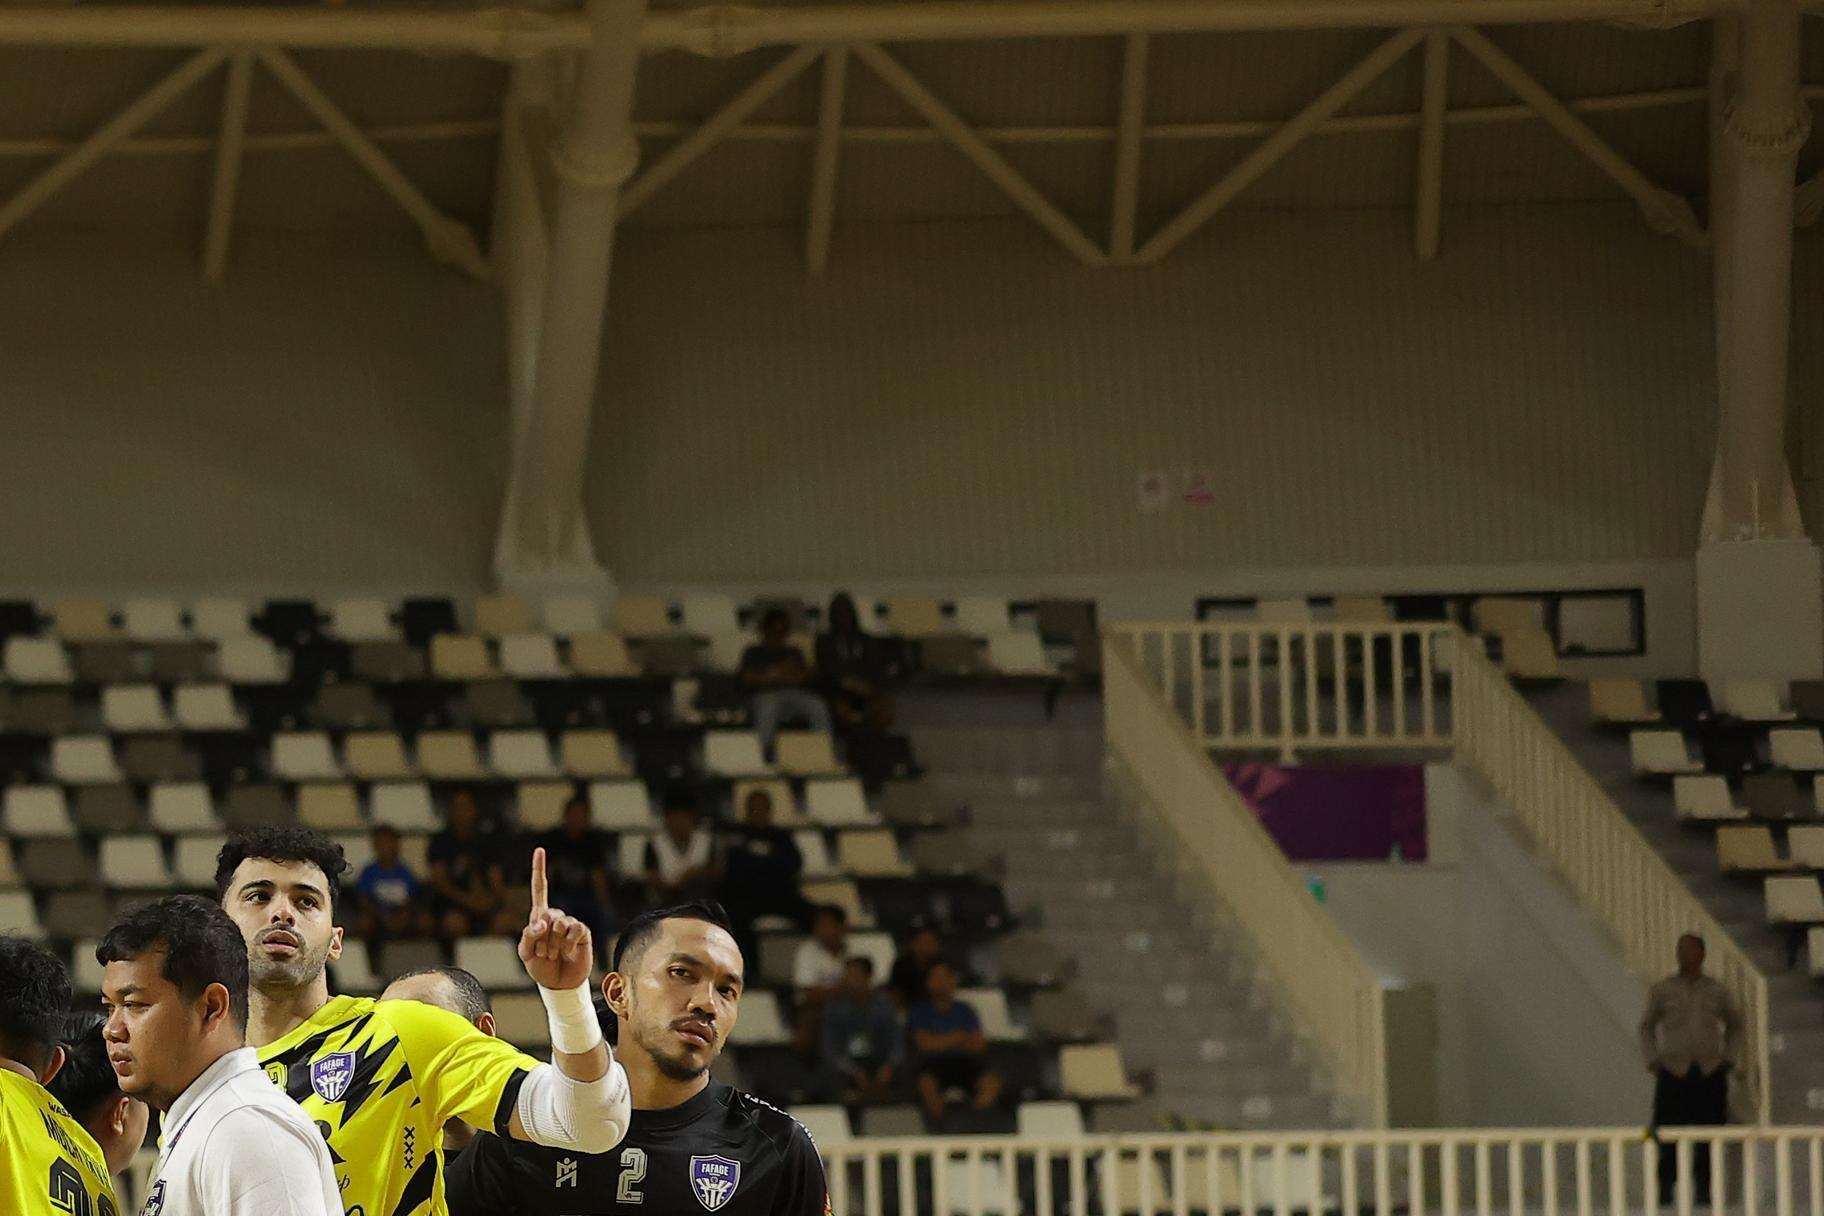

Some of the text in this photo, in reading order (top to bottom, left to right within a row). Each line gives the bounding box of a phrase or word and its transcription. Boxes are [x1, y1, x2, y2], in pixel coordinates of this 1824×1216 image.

[319, 1057, 345, 1073] FAFAGE
[616, 1147, 648, 1205] 2
[701, 1163, 729, 1176] FAFAGE
